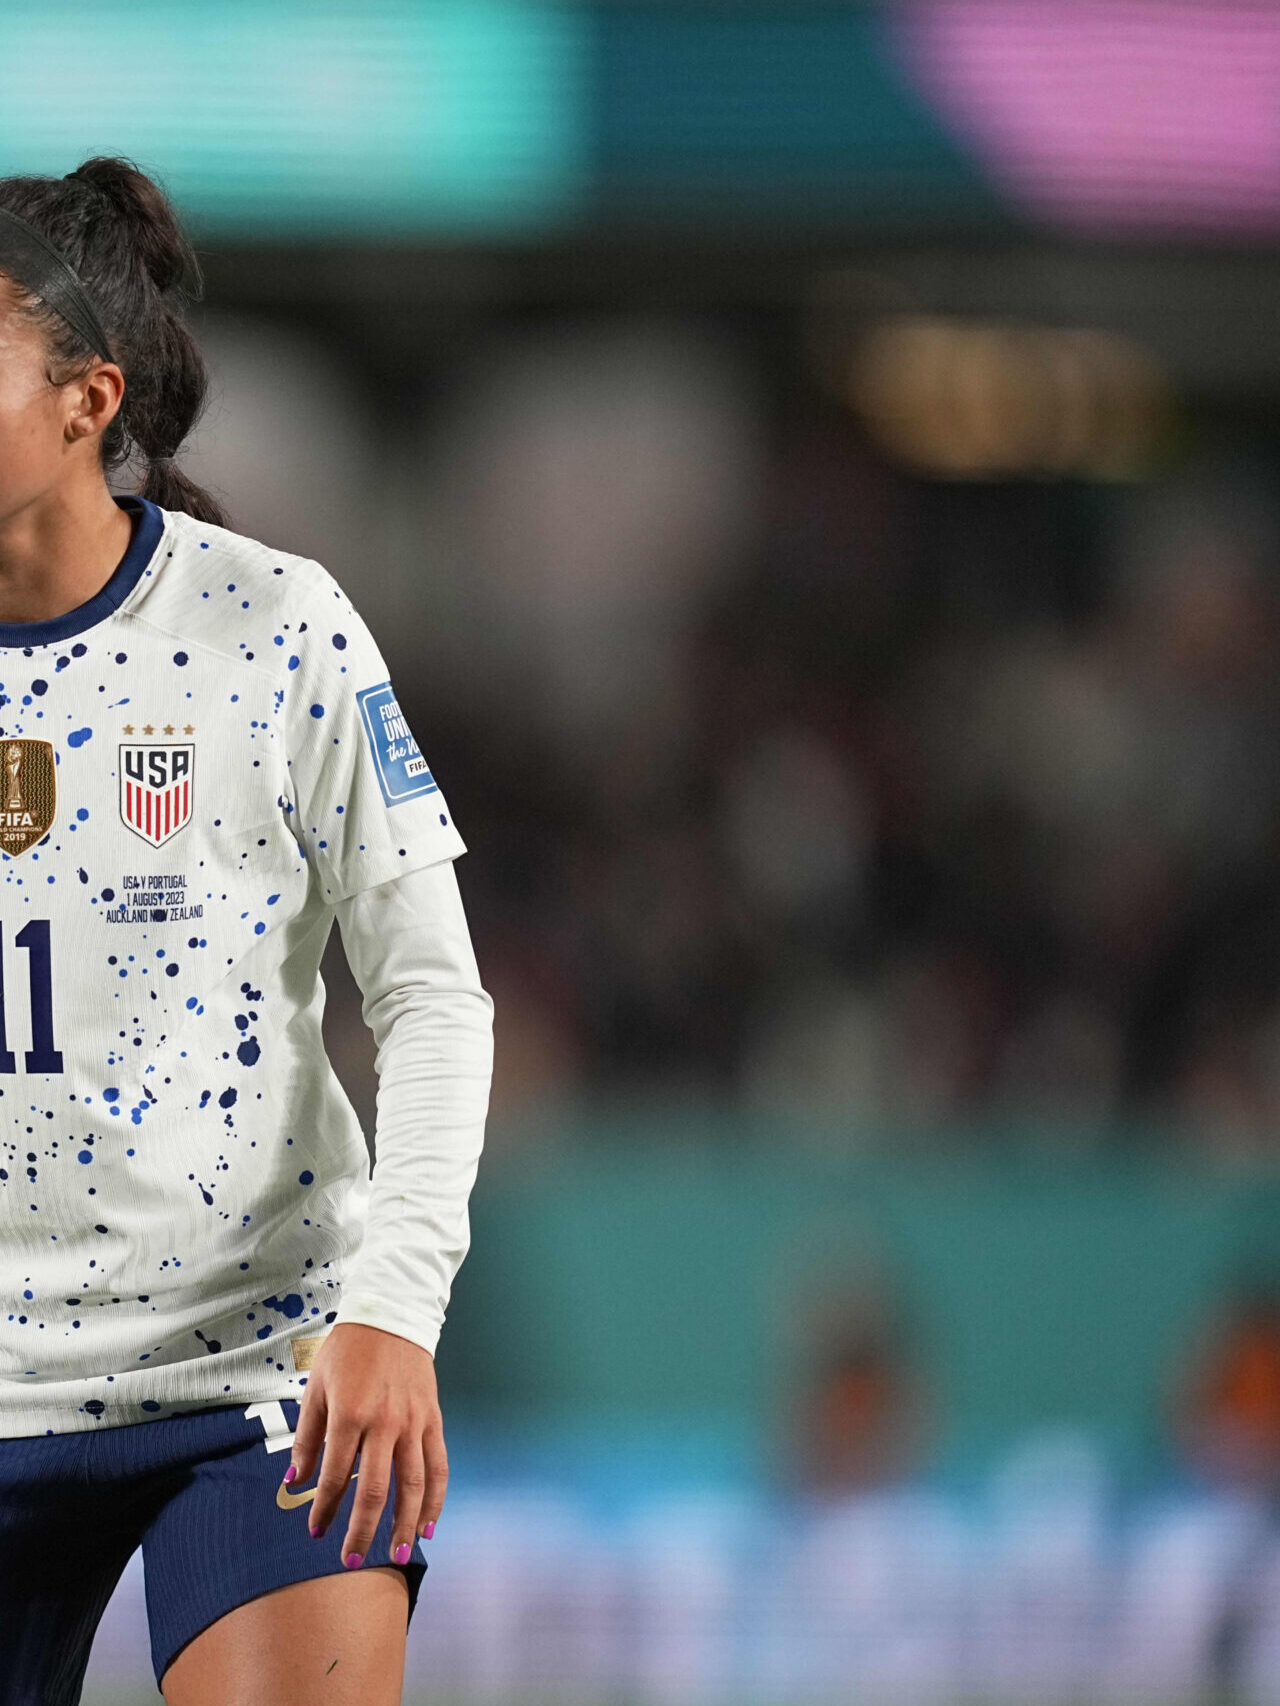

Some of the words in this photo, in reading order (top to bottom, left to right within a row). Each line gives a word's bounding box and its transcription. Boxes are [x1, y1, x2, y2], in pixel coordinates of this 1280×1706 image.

[386, 742, 407, 762] the
[126, 751, 189, 788] USA
[4, 833, 26, 841] 2019
[123, 876, 139, 889] USA
[148, 875, 187, 889] PORTUGAL
[127, 892, 131, 906] 1
[133, 892, 163, 906] AUGUST
[166, 891, 185, 905] 2023
[106, 909, 148, 923] AUCKLAND
[150, 908, 169, 922] NW
[170, 905, 203, 921] ZEALAND
[244, 1400, 303, 1454] 1
